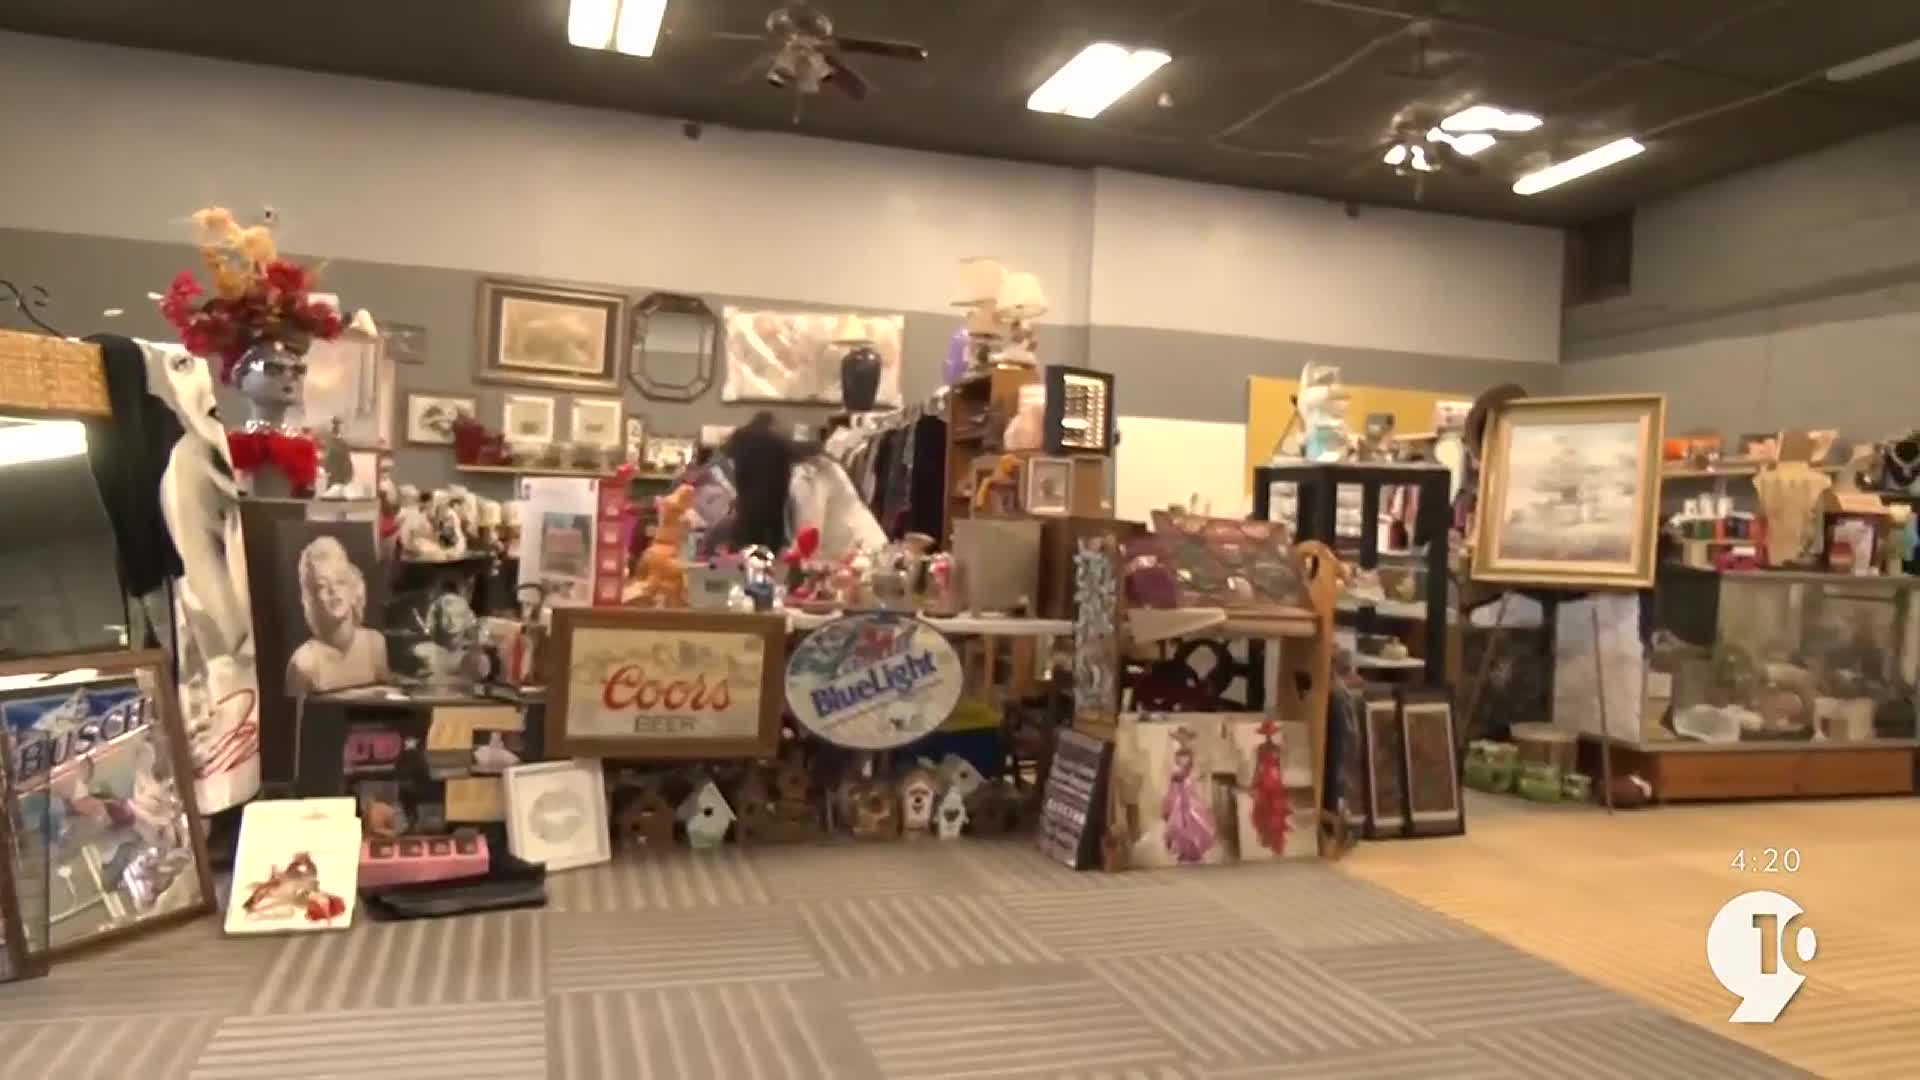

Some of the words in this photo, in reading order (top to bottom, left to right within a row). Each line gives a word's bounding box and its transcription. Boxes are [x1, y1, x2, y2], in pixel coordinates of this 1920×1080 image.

[603, 664, 731, 711] Coors
[16, 697, 146, 780] BUSCH
[633, 714, 698, 733] BEER
